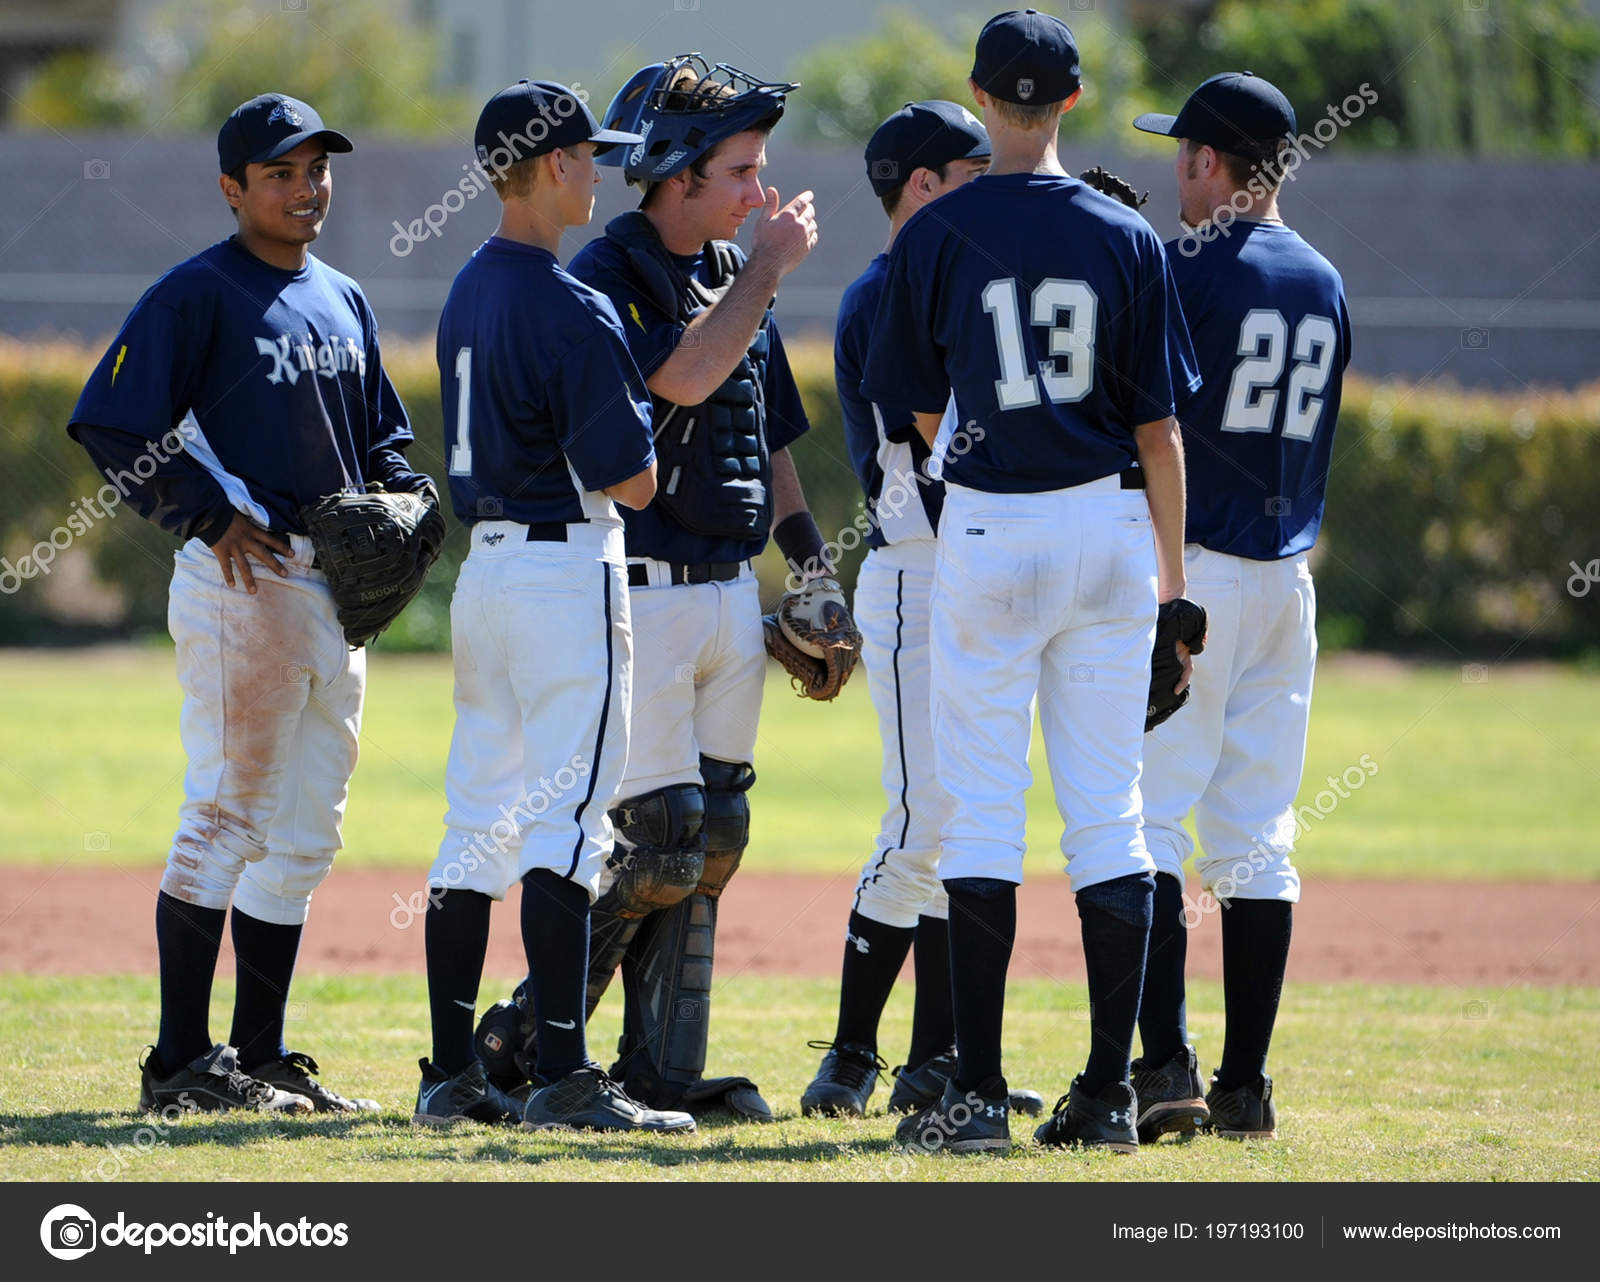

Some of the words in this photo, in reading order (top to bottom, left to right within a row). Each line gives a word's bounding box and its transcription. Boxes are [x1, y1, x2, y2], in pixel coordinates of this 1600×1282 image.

[448, 346, 472, 476] 1
[981, 277, 1099, 412] 13
[1220, 308, 1337, 443] 22
